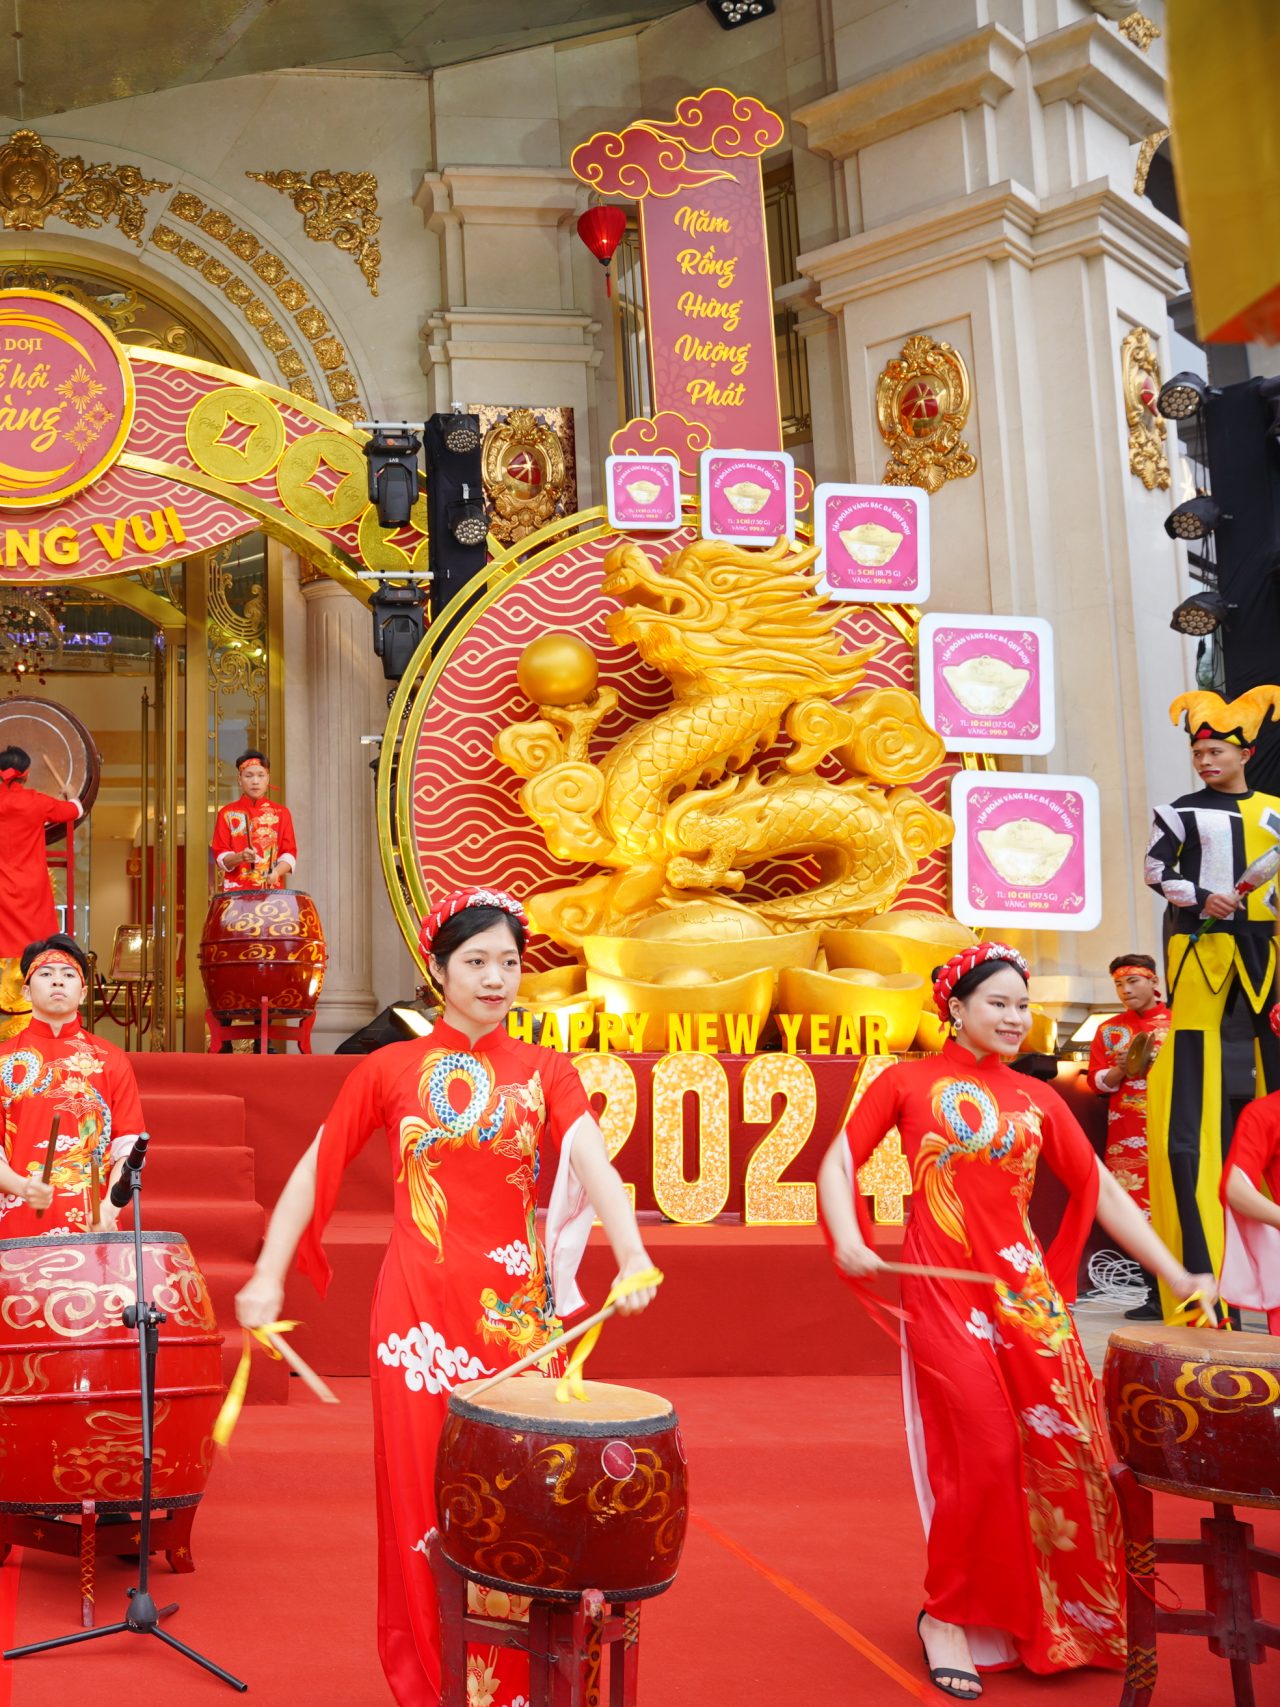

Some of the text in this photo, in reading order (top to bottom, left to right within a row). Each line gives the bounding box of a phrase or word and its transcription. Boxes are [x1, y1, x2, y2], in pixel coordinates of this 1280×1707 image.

[674, 206, 732, 239] Năm
[676, 245, 738, 289] Rồng
[677, 291, 744, 332] Hưng
[5, 338, 43, 355] DOJI
[675, 334, 752, 376] Vượng
[9, 362, 51, 396] hội
[686, 379, 747, 406] Phát
[91, 506, 187, 560] VUI
[965, 632, 984, 640] VÀNG
[985, 798, 1004, 815] ĐOÀN
[1003, 792, 1023, 802] VÀNG
[1024, 793, 1039, 801] BẠC
[1040, 797, 1050, 806] ĐÁ
[1028, 901, 1049, 909] 999.9
[507, 1012, 889, 1056] HAPPY NEW YEAR
